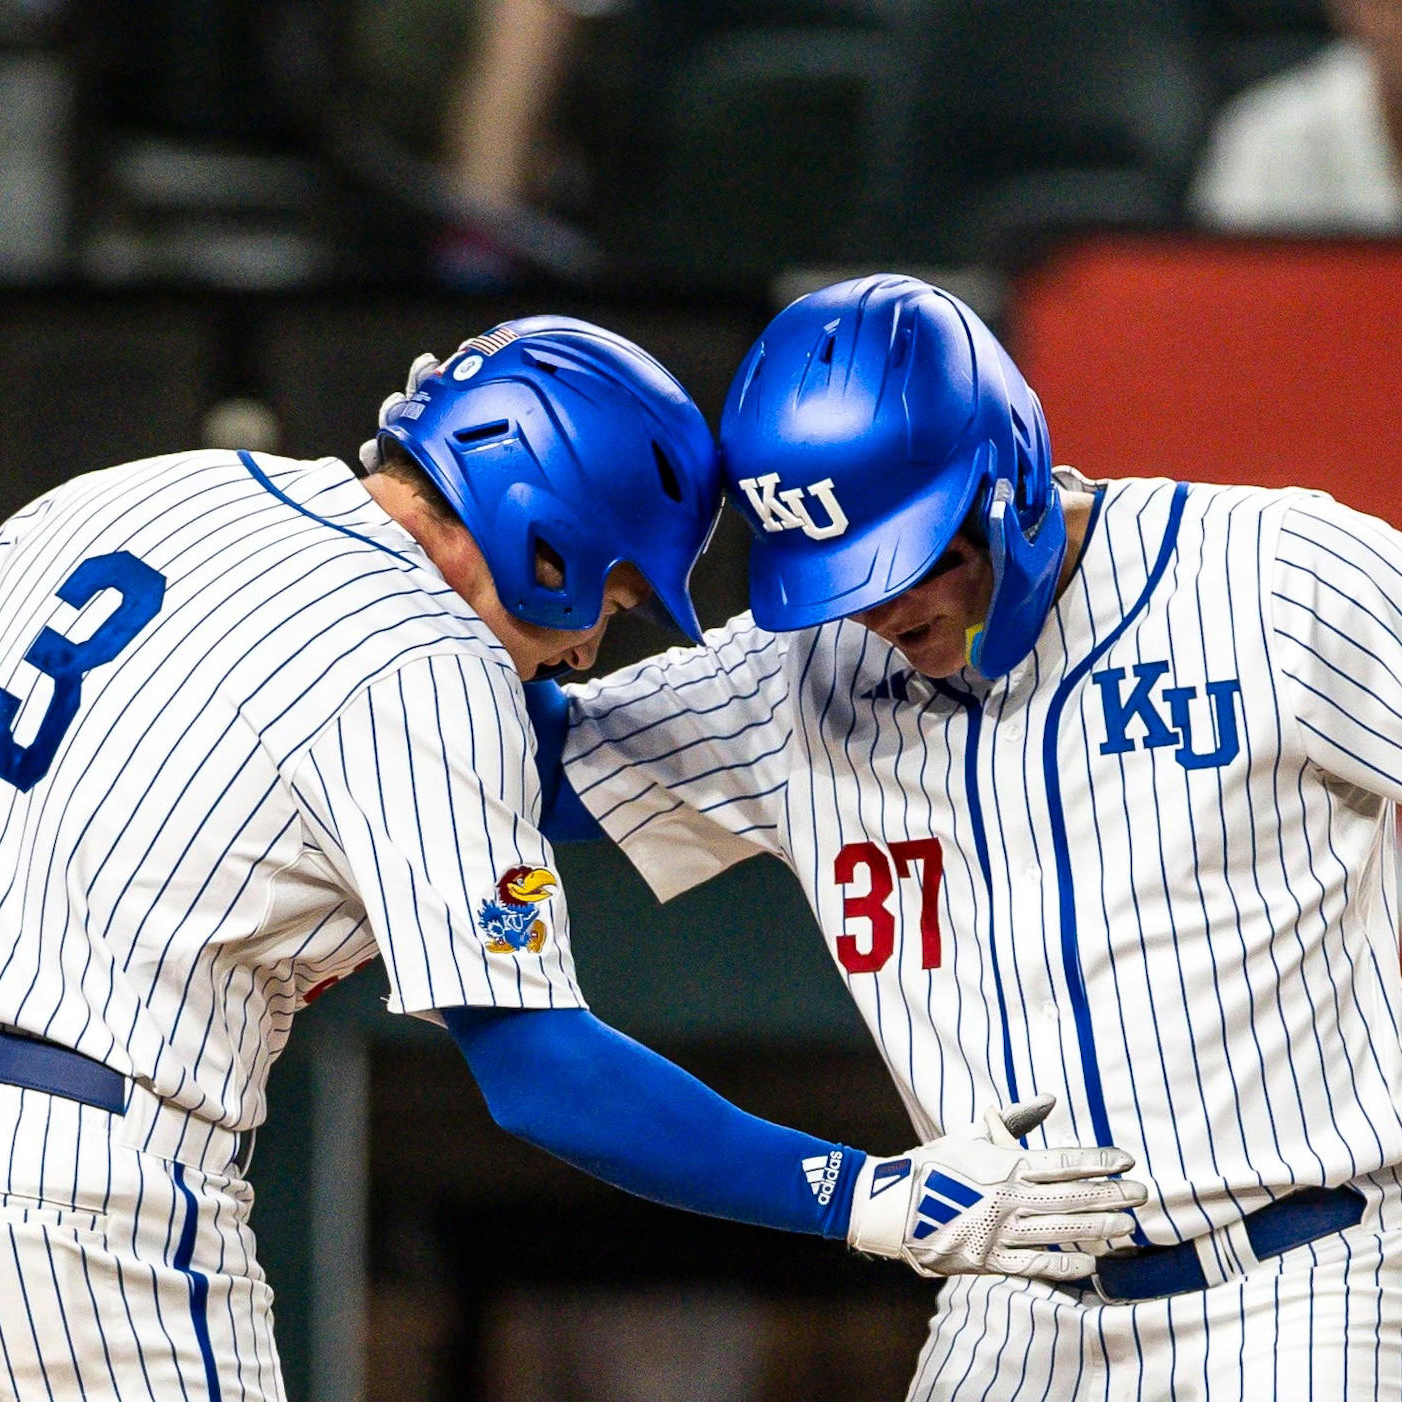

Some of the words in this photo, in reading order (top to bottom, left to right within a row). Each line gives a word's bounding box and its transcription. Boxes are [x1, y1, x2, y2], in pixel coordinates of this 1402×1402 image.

[738, 472, 849, 540] KU
[1092, 660, 1240, 770] KU
[834, 837, 943, 974] 37
[818, 1151, 843, 1205] adidas
